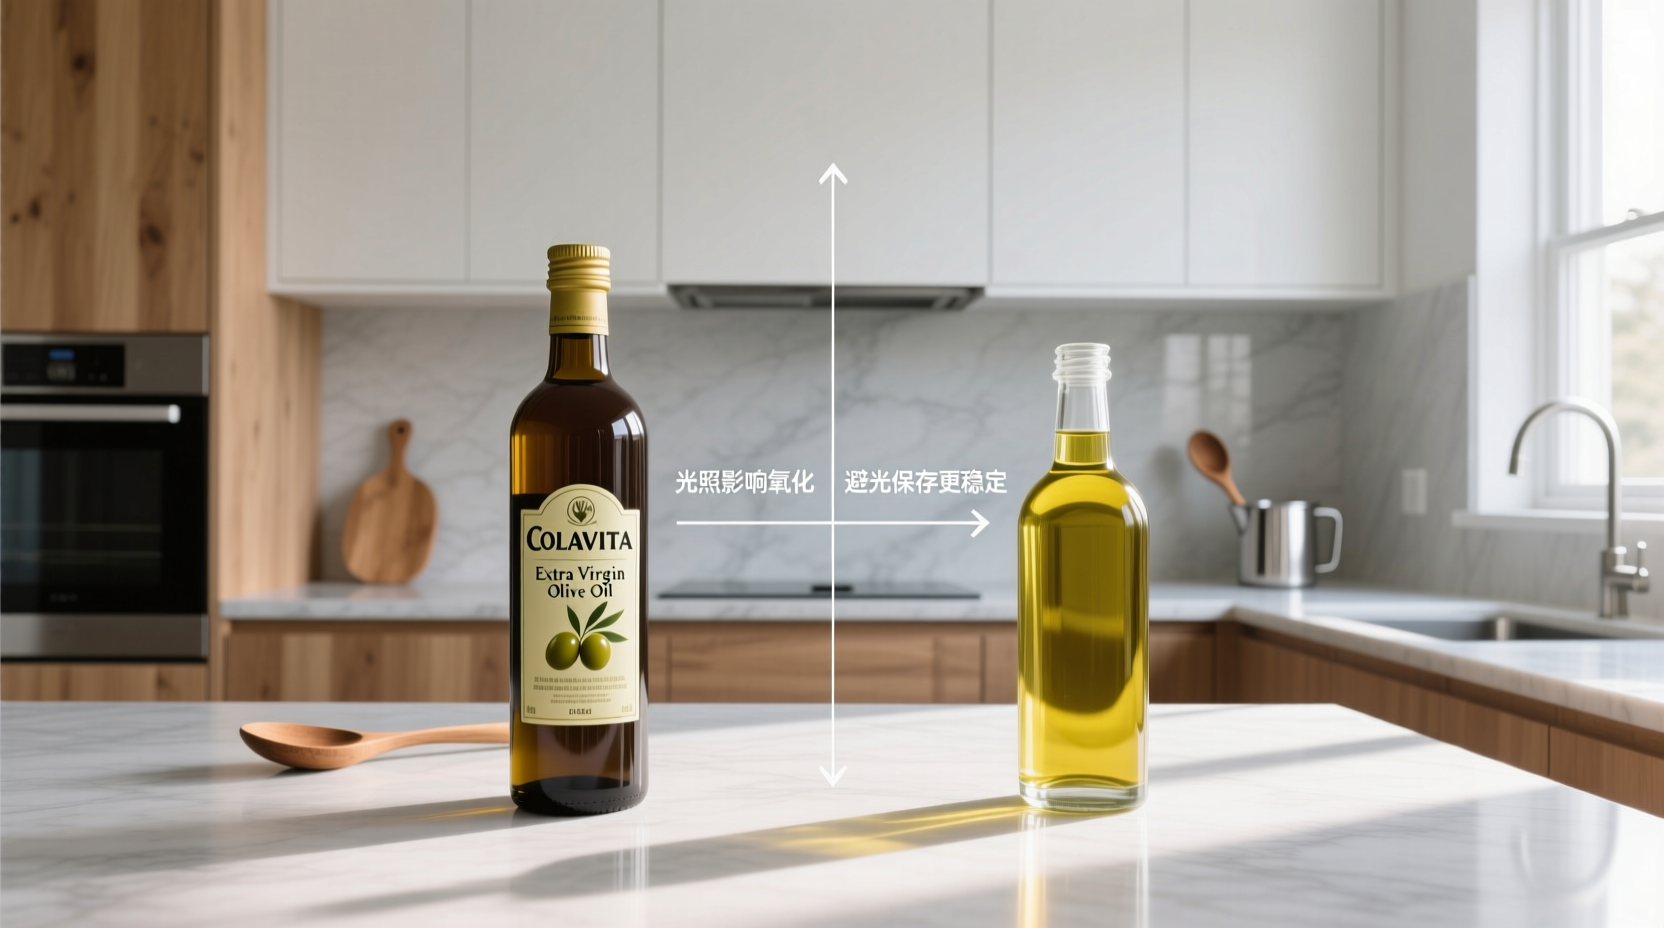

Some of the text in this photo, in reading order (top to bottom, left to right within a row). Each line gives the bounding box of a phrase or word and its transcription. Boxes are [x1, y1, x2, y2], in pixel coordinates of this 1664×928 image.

[526, 525, 633, 551] COLAVITA
[535, 565, 625, 586] Extra Virgin
[547, 583, 613, 598] Olive Oil
